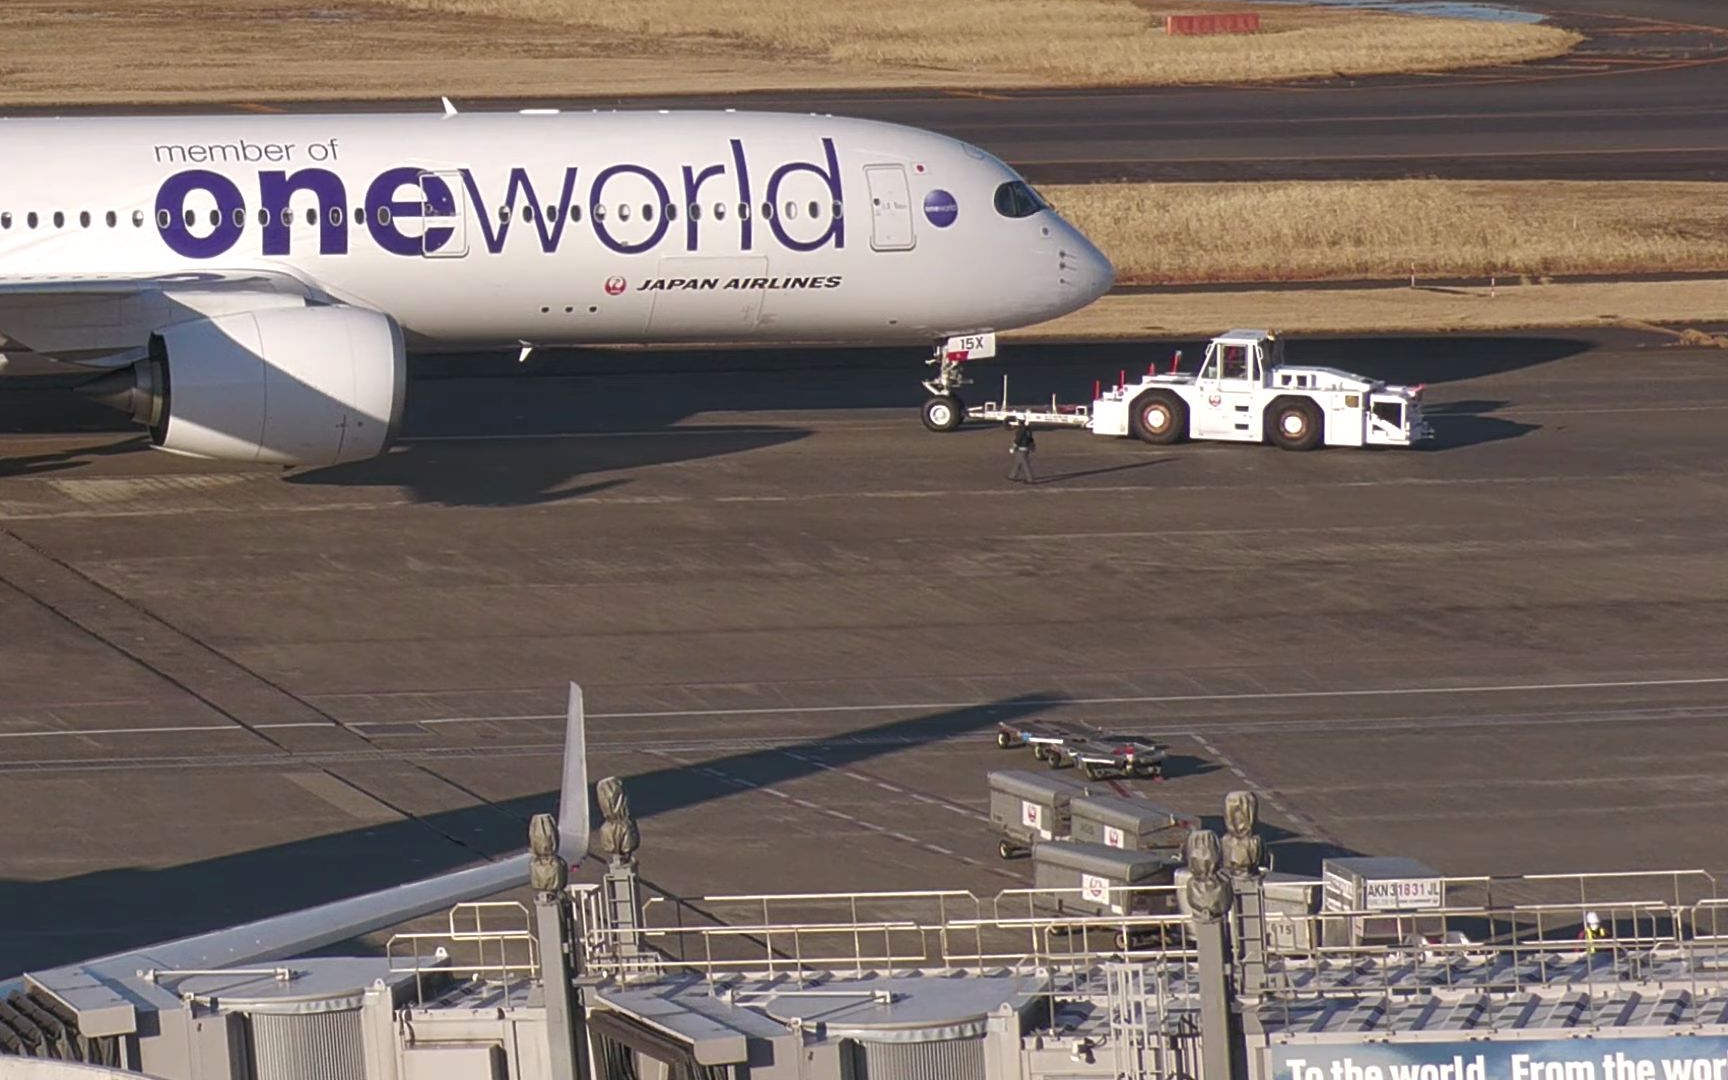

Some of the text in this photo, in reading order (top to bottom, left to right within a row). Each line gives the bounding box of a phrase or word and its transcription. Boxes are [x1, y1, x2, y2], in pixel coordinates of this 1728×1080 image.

[154, 138, 339, 163] member of
[154, 137, 845, 260] oneworld
[637, 278, 719, 291] JAPAN
[723, 276, 842, 290] AIRLINES
[960, 336, 984, 350] 15X
[1368, 883, 1389, 897] AKN
[1511, 1054, 1594, 1080] From
[1602, 1052, 1655, 1080] the
[1662, 1051, 1728, 1080] wor
